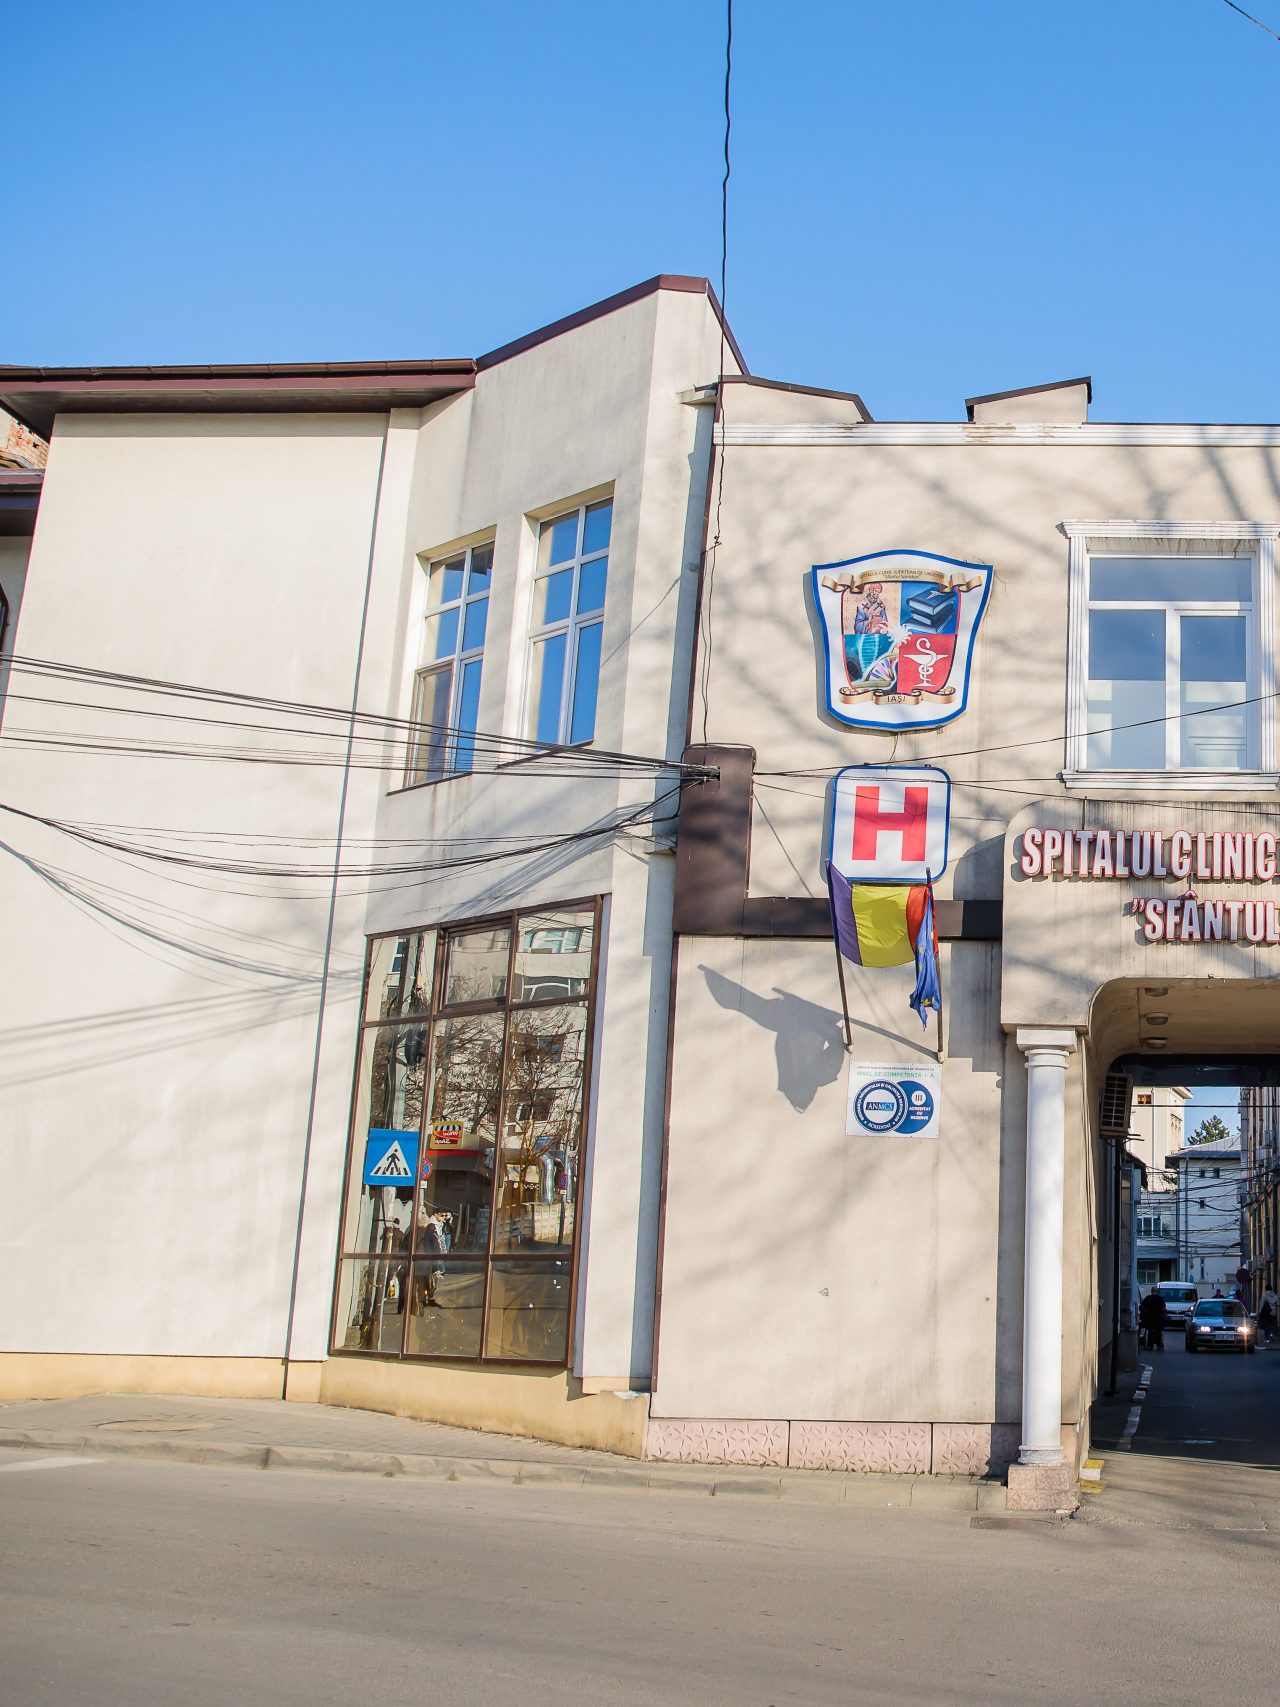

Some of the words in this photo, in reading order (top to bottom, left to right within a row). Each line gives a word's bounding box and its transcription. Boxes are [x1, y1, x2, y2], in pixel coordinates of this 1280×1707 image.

[852, 786, 929, 861] H
[1021, 827, 1167, 879] SPITALUL
[1170, 830, 1278, 881] CLINIC
[868, 1102, 893, 1110] ANMCS
